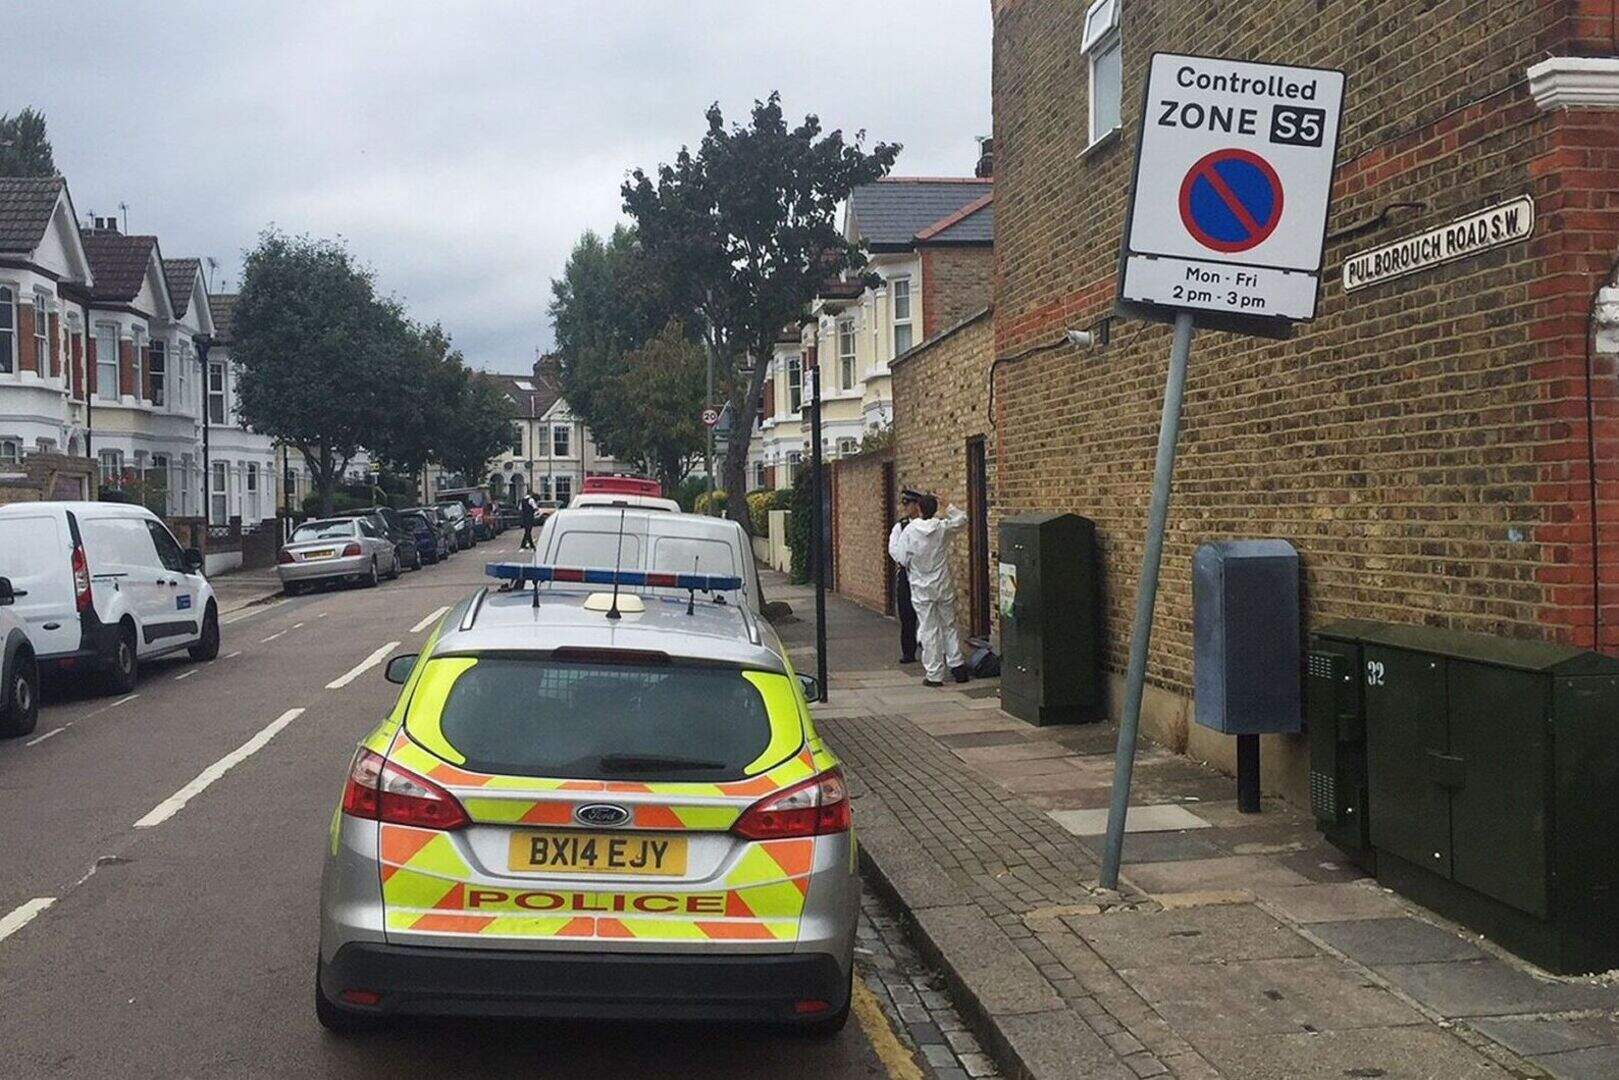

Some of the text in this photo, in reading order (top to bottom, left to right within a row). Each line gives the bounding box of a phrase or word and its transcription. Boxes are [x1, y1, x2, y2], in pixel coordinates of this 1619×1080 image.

[1176, 66, 1317, 101] Controlled
[1157, 100, 1321, 142] ZONE S5
[1446, 218, 1488, 254] ROAD
[1186, 267, 1220, 283] Mon
[1236, 273, 1257, 287] Fri
[704, 412, 716, 421] 20
[1367, 660, 1385, 686] 32
[588, 808, 616, 821] Ford
[530, 837, 669, 868] BX14 EJY
[469, 890, 724, 913] POLICE
